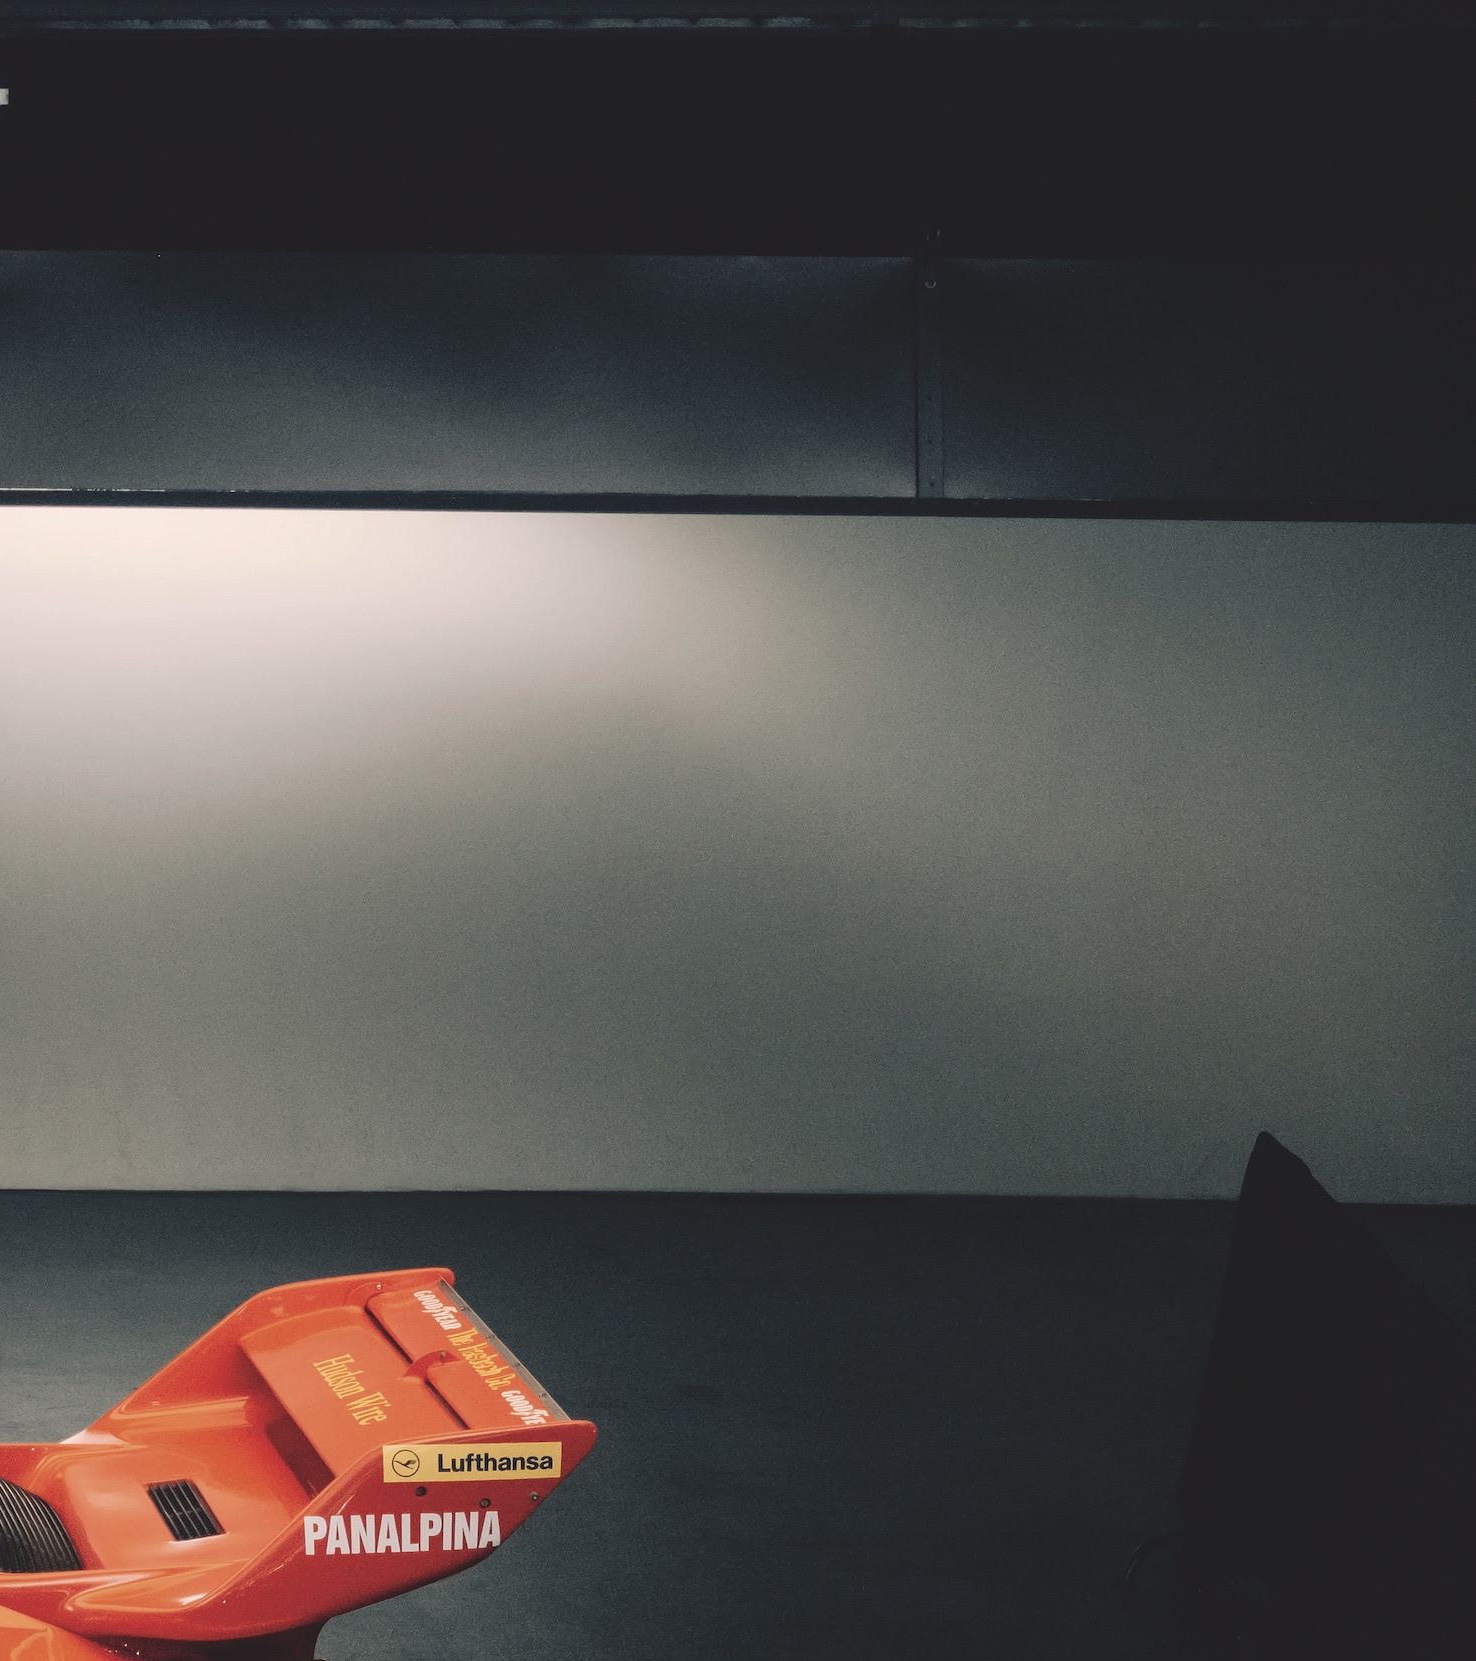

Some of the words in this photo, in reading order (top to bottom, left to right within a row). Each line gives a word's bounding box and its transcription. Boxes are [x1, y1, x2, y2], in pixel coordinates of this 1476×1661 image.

[312, 1353, 365, 1400] Hudson
[345, 1391, 392, 1426] Wire
[500, 1390, 550, 1425] GOODYE
[436, 1452, 554, 1474] Lufthansa
[303, 1511, 502, 1555] PANALPINA
